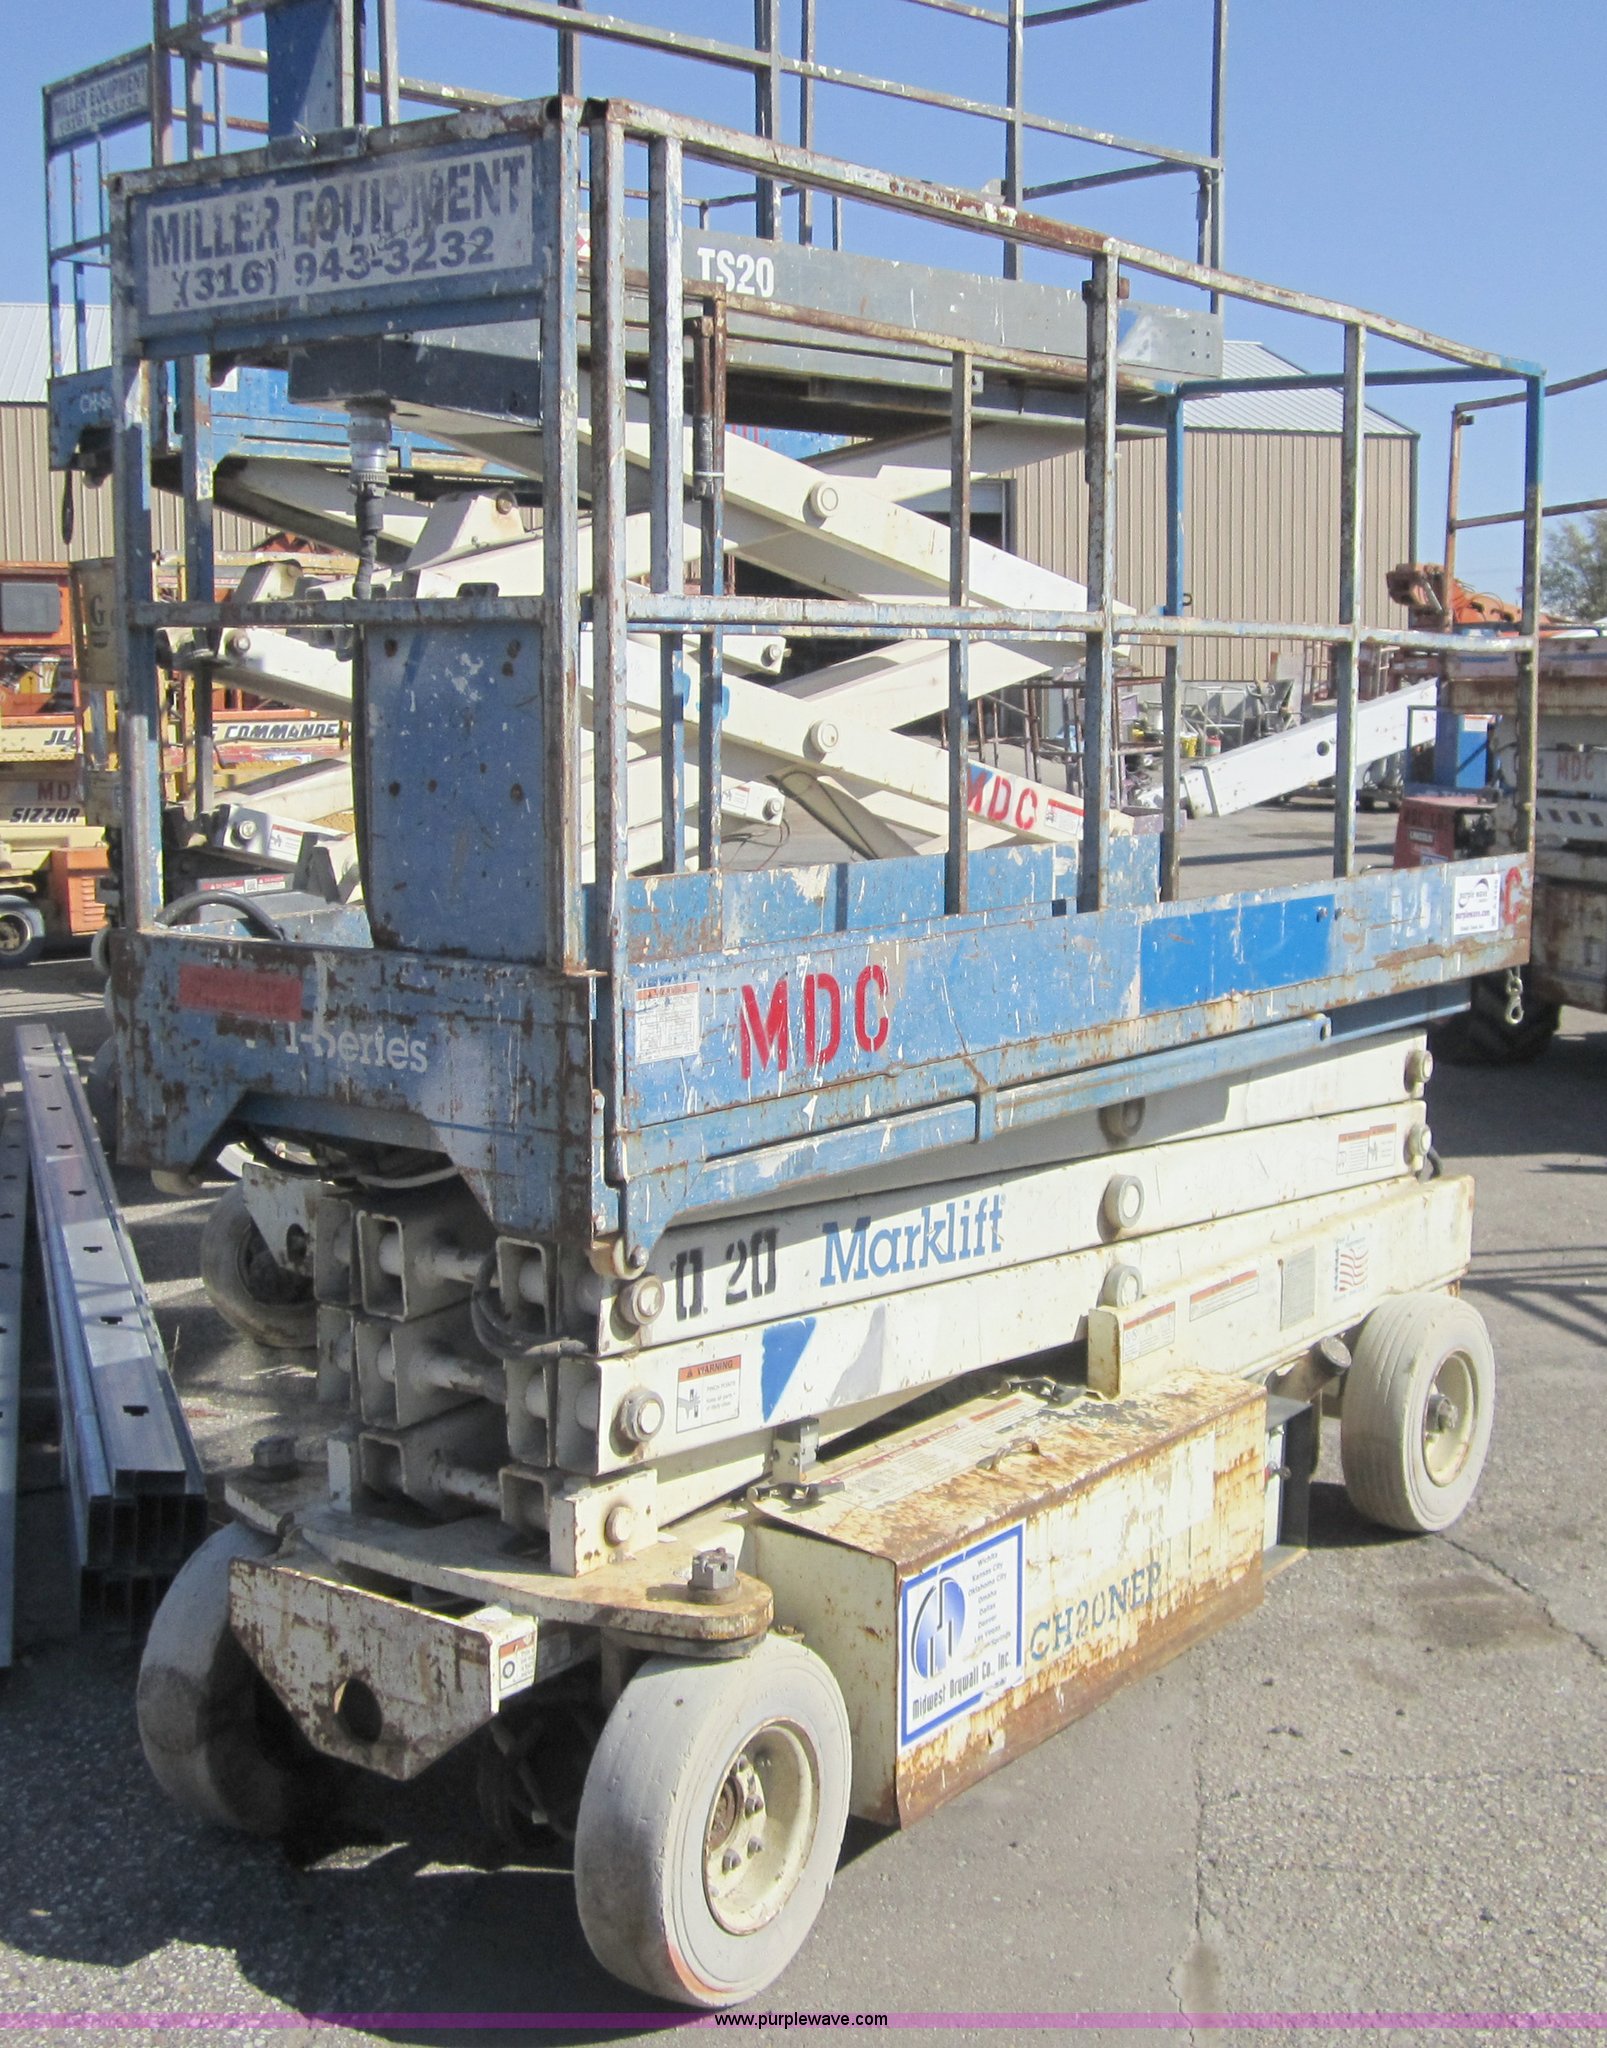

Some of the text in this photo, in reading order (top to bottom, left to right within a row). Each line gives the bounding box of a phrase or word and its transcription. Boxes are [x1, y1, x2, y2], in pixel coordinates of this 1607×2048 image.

[152, 154, 526, 267] MILLER EQUIPMENT
[294, 226, 495, 287] 943-3232
[697, 247, 774, 297] TS20
[224, 723, 340, 739] COMMANDE
[9, 807, 80, 823] SIZZOR
[740, 964, 889, 1081] MDC
[820, 1194, 1004, 1287] Marklift
[698, 1360, 733, 1375] WARNING
[912, 1683, 946, 1720] Midwest
[950, 1665, 979, 1698] Drywall
